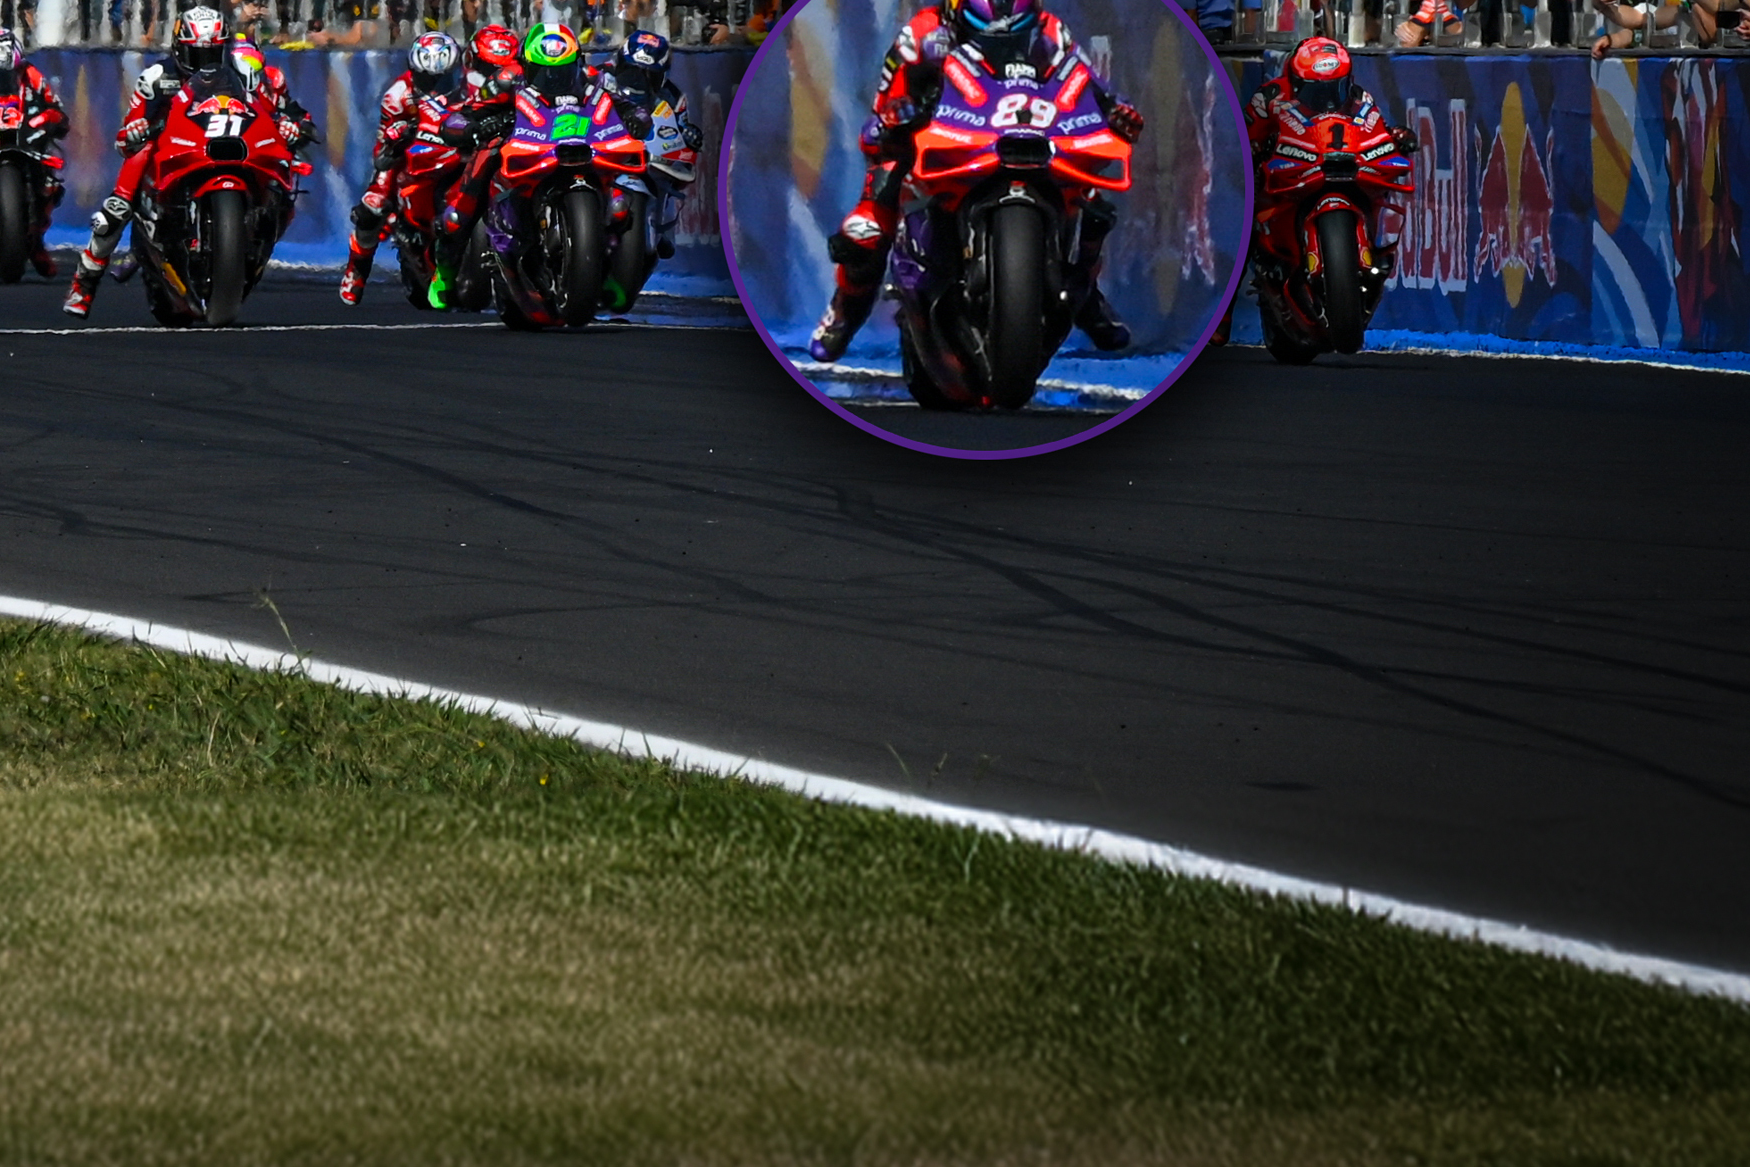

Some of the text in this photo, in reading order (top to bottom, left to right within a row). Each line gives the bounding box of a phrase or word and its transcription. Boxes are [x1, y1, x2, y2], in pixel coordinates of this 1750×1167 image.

[936, 105, 986, 126] prima
[991, 93, 1057, 128] 89
[205, 114, 243, 137] 31
[514, 127, 547, 140] prima
[551, 113, 591, 141] 21
[1057, 113, 1102, 135] prima
[1326, 124, 1348, 150] 1
[1276, 144, 1317, 161] Lenovo
[1361, 142, 1395, 161] Lenovo
